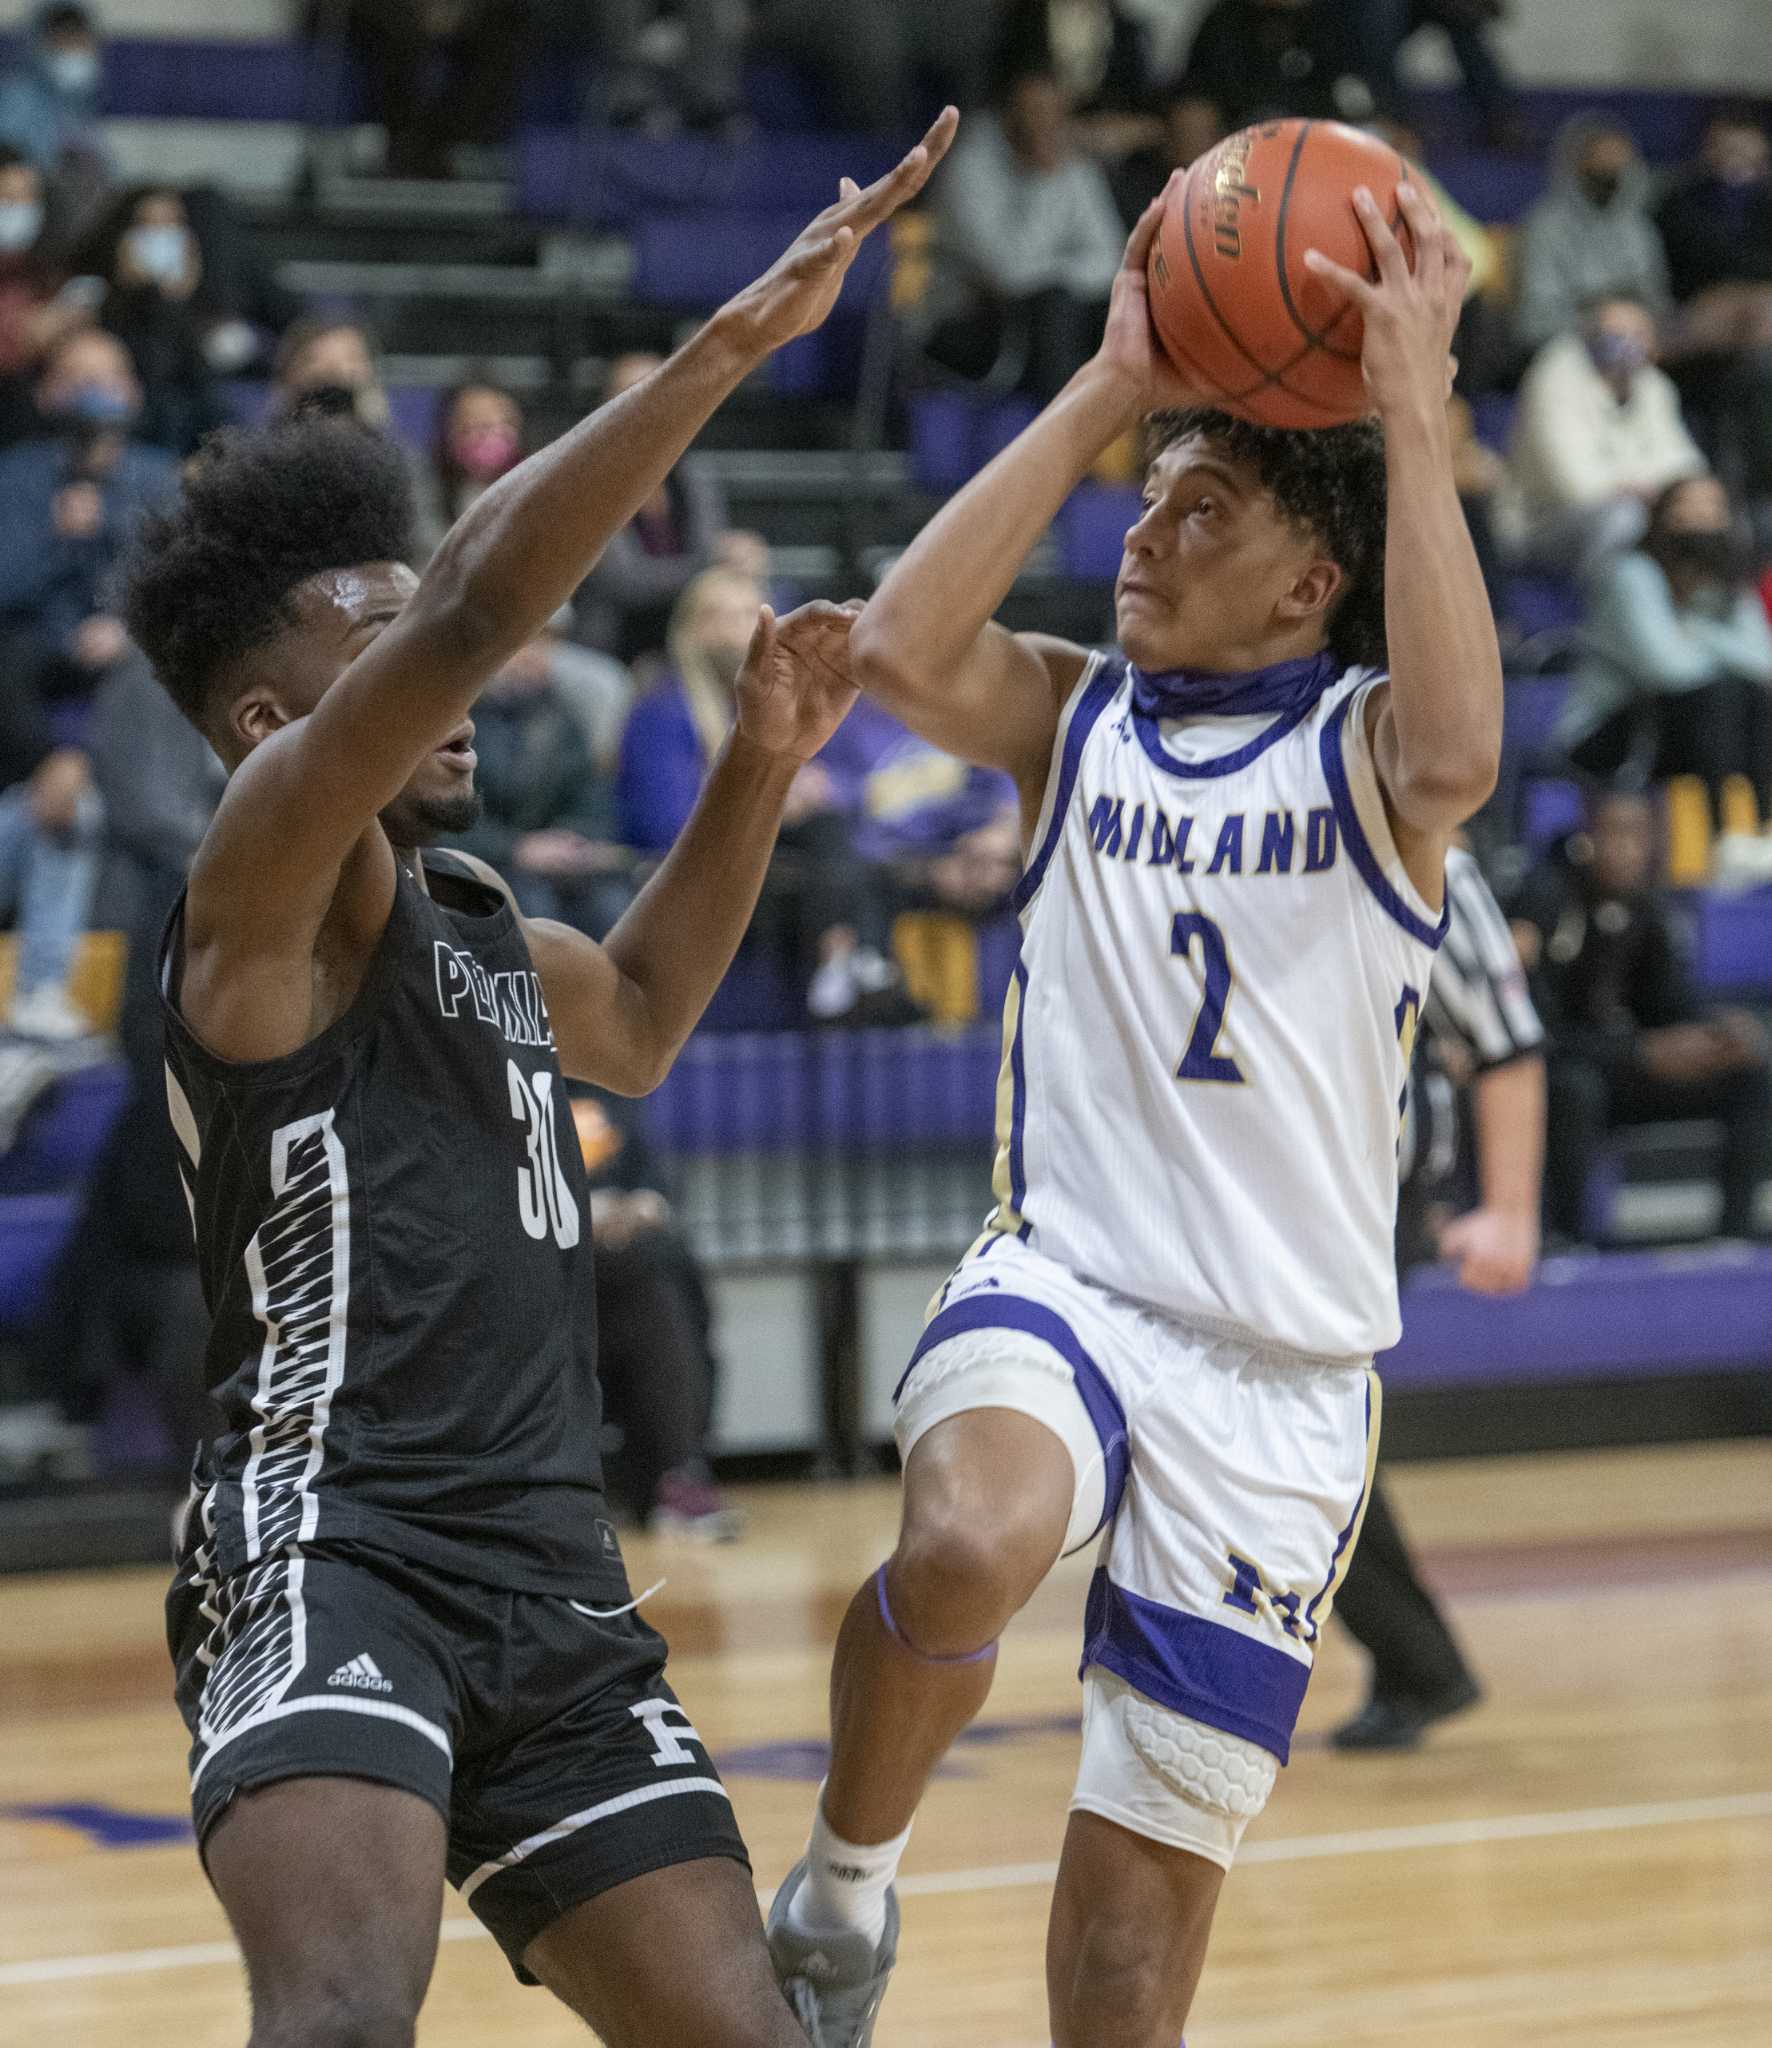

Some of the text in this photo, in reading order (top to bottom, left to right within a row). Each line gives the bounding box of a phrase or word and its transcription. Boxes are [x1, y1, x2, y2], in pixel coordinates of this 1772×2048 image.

[1088, 793, 1339, 876] MIDLAND
[1170, 911, 1246, 1085] 2
[506, 1058, 580, 1250] 30
[327, 1671, 393, 1694] adidas
